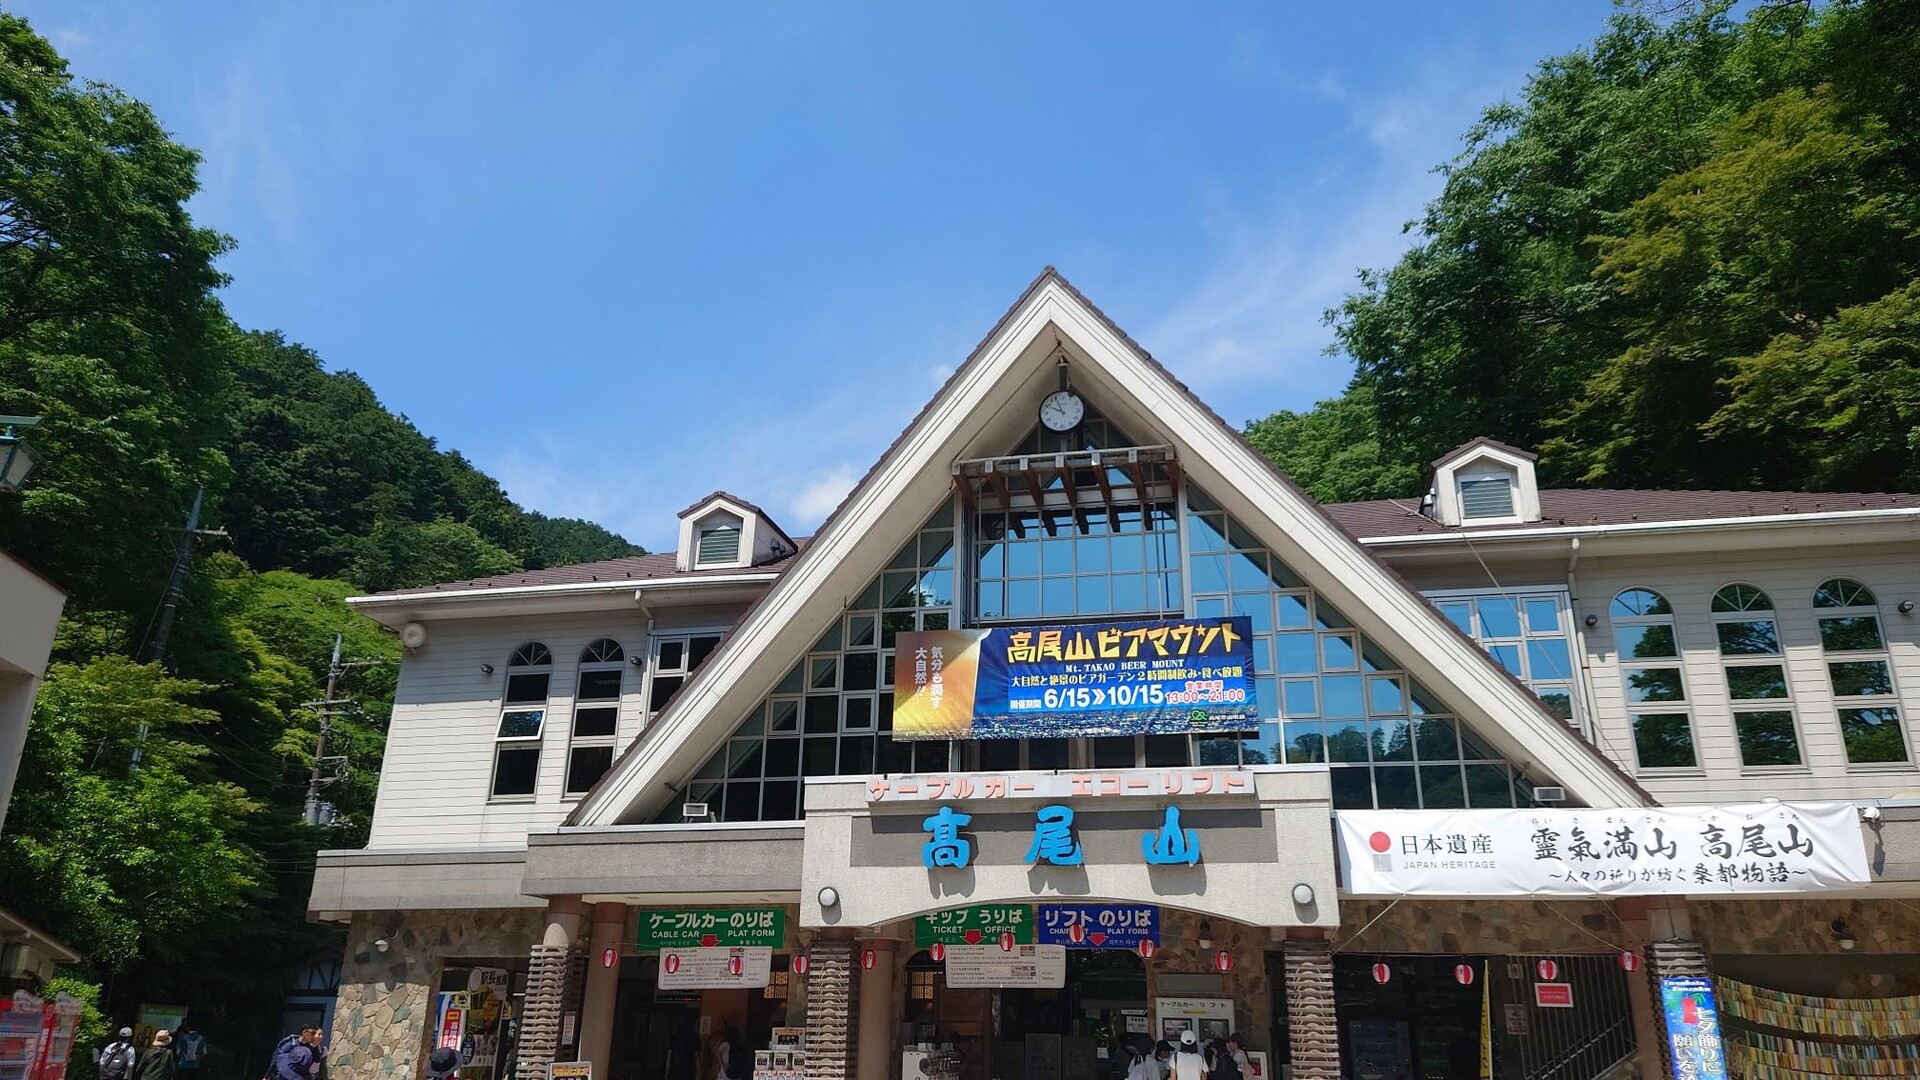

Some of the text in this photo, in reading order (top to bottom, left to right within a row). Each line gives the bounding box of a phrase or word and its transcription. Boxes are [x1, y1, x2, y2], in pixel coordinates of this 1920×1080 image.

[1007, 623, 1241, 663] 高尾山ビアマウント
[1065, 659, 1184, 673] Mt. TAKAO BEER MOUNT
[869, 773, 1245, 801] ケーブルカー エコー リフト
[1402, 834, 1493, 854] 日本遺産
[1699, 823, 1813, 859] 高尾山
[1403, 861, 1496, 869] JAPAN HERITAGE
[649, 912, 774, 929] ケーブルカーのりば
[979, 909, 1022, 924] うりば
[682, 930, 699, 938] CAR
[751, 929, 774, 937] FORM
